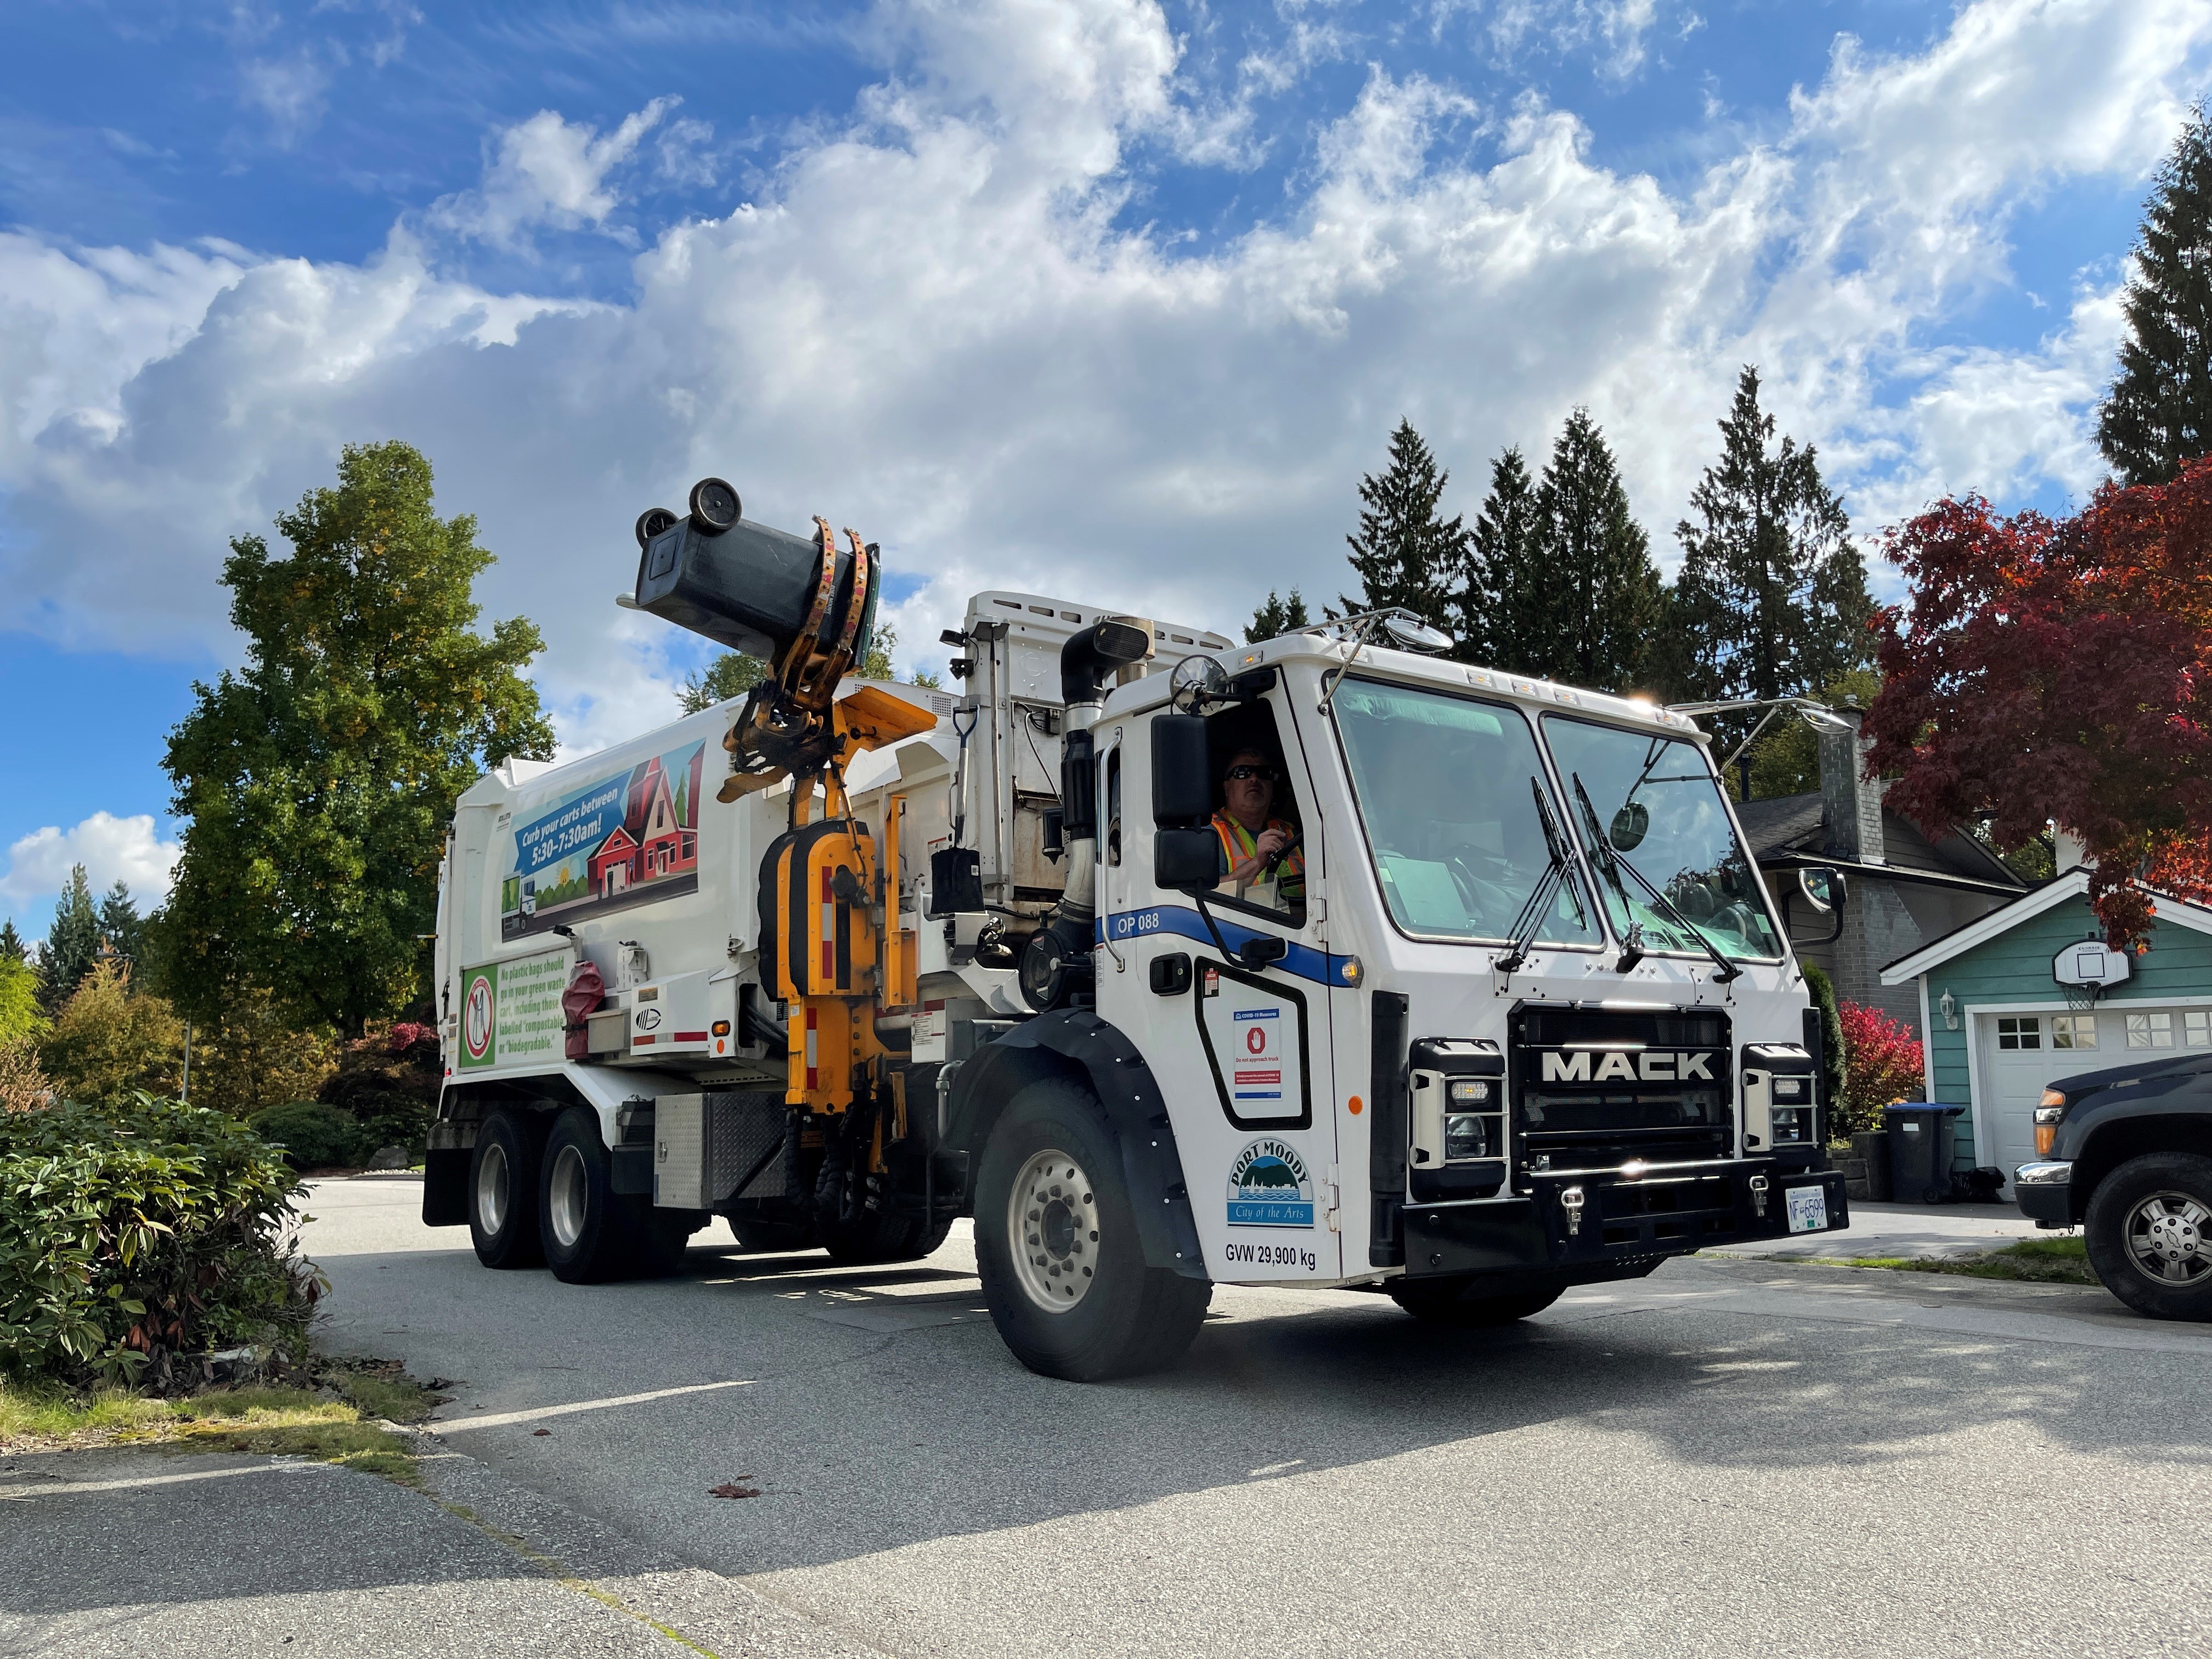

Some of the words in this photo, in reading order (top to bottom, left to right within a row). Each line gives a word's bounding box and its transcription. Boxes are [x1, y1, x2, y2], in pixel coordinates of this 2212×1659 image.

[522, 826, 540, 847] Curb
[540, 819, 560, 842] your
[560, 808, 580, 827] carts
[580, 788, 618, 817] between
[1118, 917, 1136, 933] OP
[1138, 912, 1159, 930] 088
[501, 968, 508, 981] No
[510, 964, 528, 983] plastic
[529, 963, 543, 978] bags
[544, 956, 564, 973] should
[500, 989, 507, 1002] go
[509, 985, 514, 998] in
[515, 985, 527, 999] your
[529, 981, 546, 998] green
[548, 977, 566, 991] waste
[515, 998, 540, 1015] including
[542, 997, 558, 1011] those
[500, 1020, 522, 1036] labelled
[499, 1043, 505, 1054] or
[1542, 1052, 1714, 1081] MACK
[1231, 1144, 1259, 1187] PORT
[1264, 1142, 1308, 1183] MOODY
[1235, 1205, 1253, 1220] City
[1256, 1205, 1264, 1220] of
[1268, 1205, 1280, 1218] the
[1284, 1206, 1304, 1218] Arts
[1789, 1200, 1798, 1221] NF
[1805, 1198, 1824, 1218] 6599
[1226, 1244, 1254, 1262] GVW
[1257, 1246, 1296, 1267] 29,900
[1300, 1248, 1316, 1271] kg
